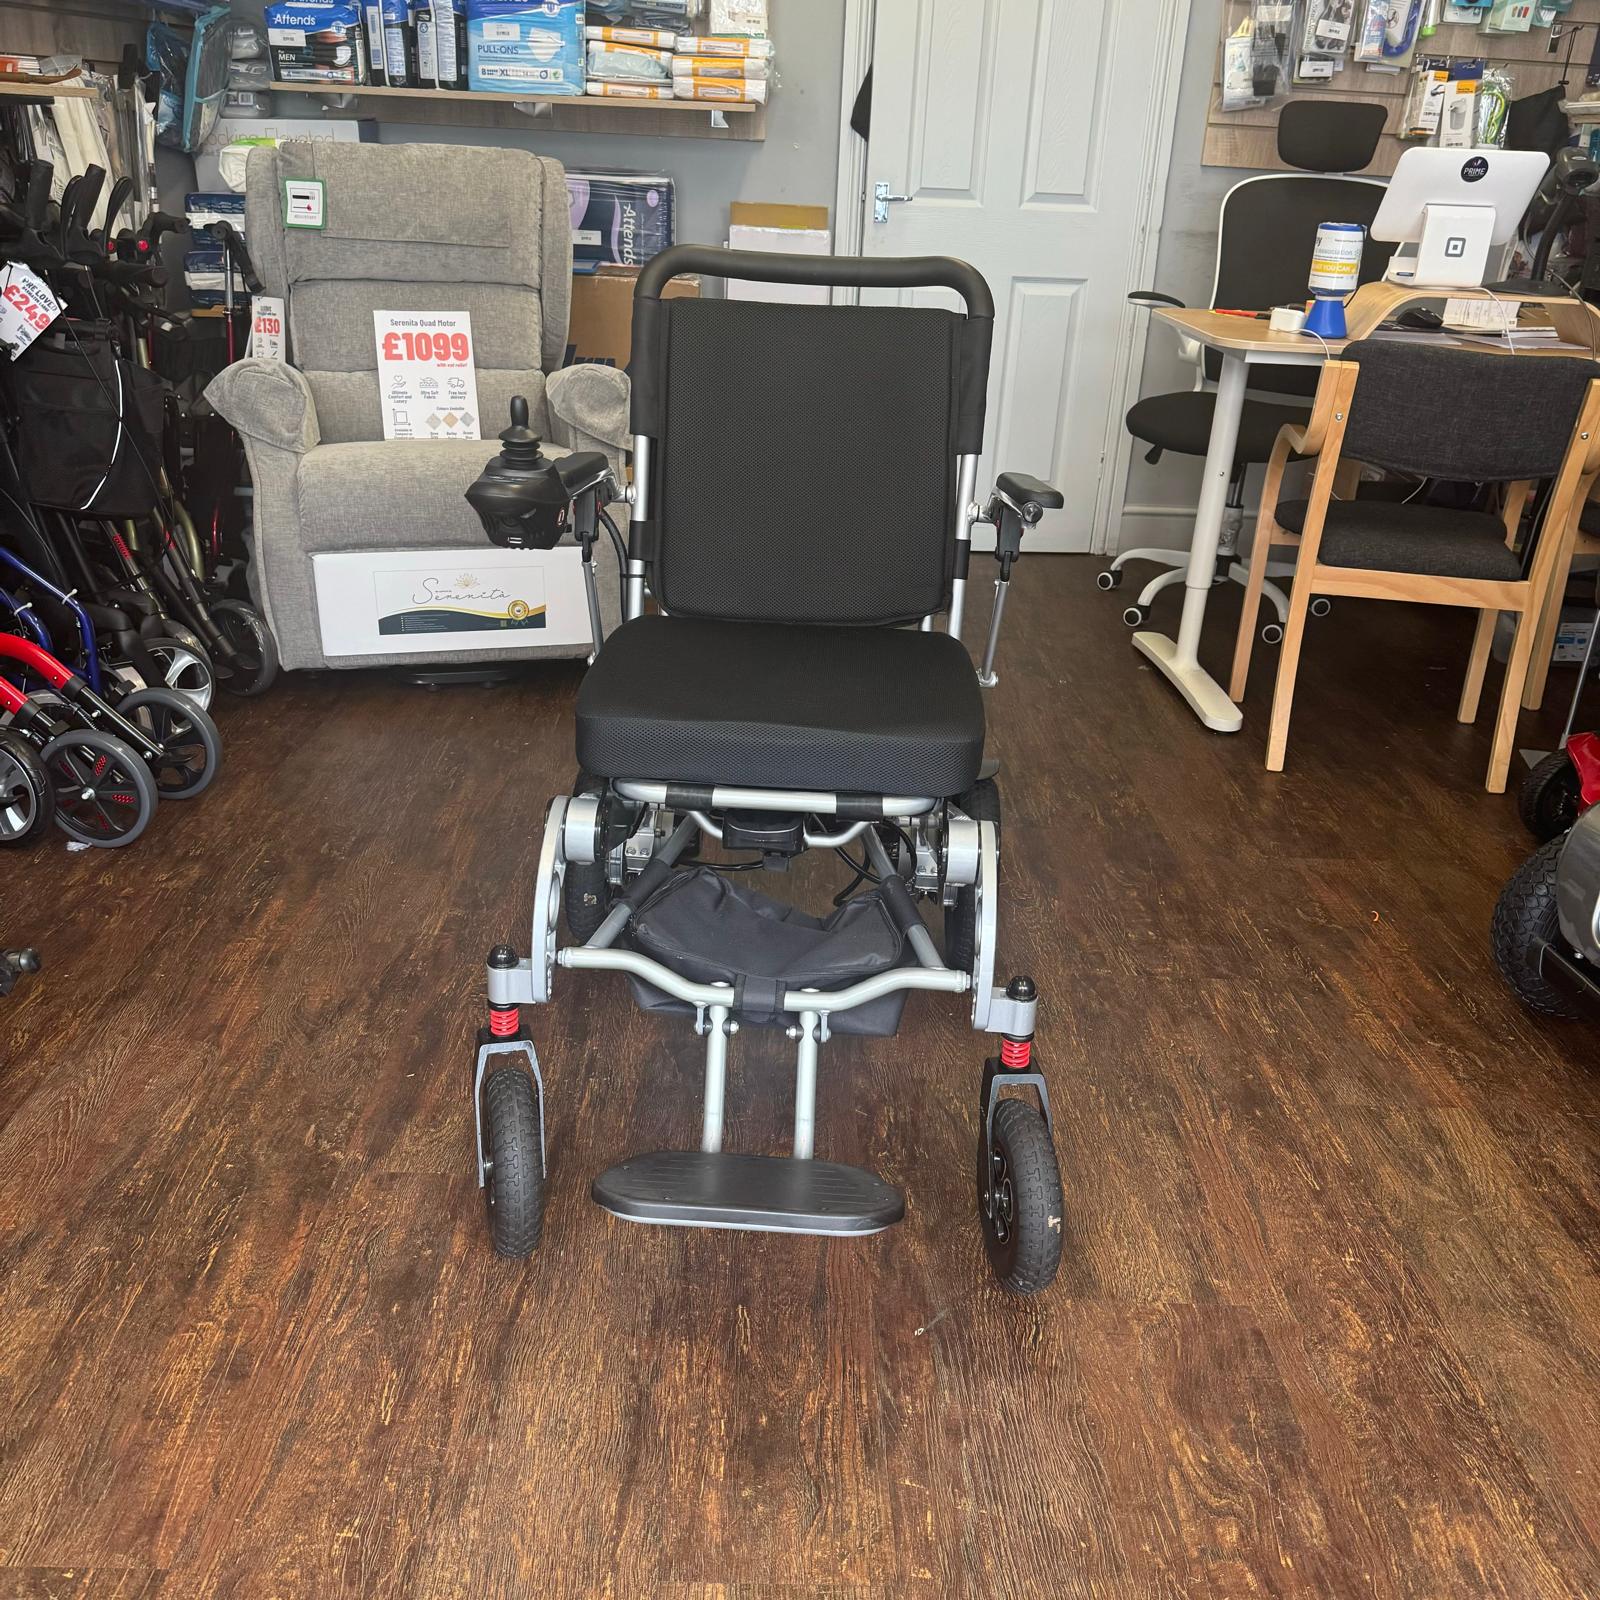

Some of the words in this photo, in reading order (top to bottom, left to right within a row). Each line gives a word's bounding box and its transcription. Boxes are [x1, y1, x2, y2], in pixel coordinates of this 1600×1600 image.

[273, 13, 316, 24] Attends
[477, 44, 519, 54] PULL-ONS
[500, 68, 510, 76] XL
[1463, 167, 1486, 176] PRIME
[623, 202, 638, 266] Attends
[22, 277, 38, 292] PRE
[35, 289, 58, 312] LOVED
[3, 285, 50, 329] £249
[254, 317, 280, 334] £130
[390, 319, 418, 327] Serenita
[382, 332, 469, 361] £1099
